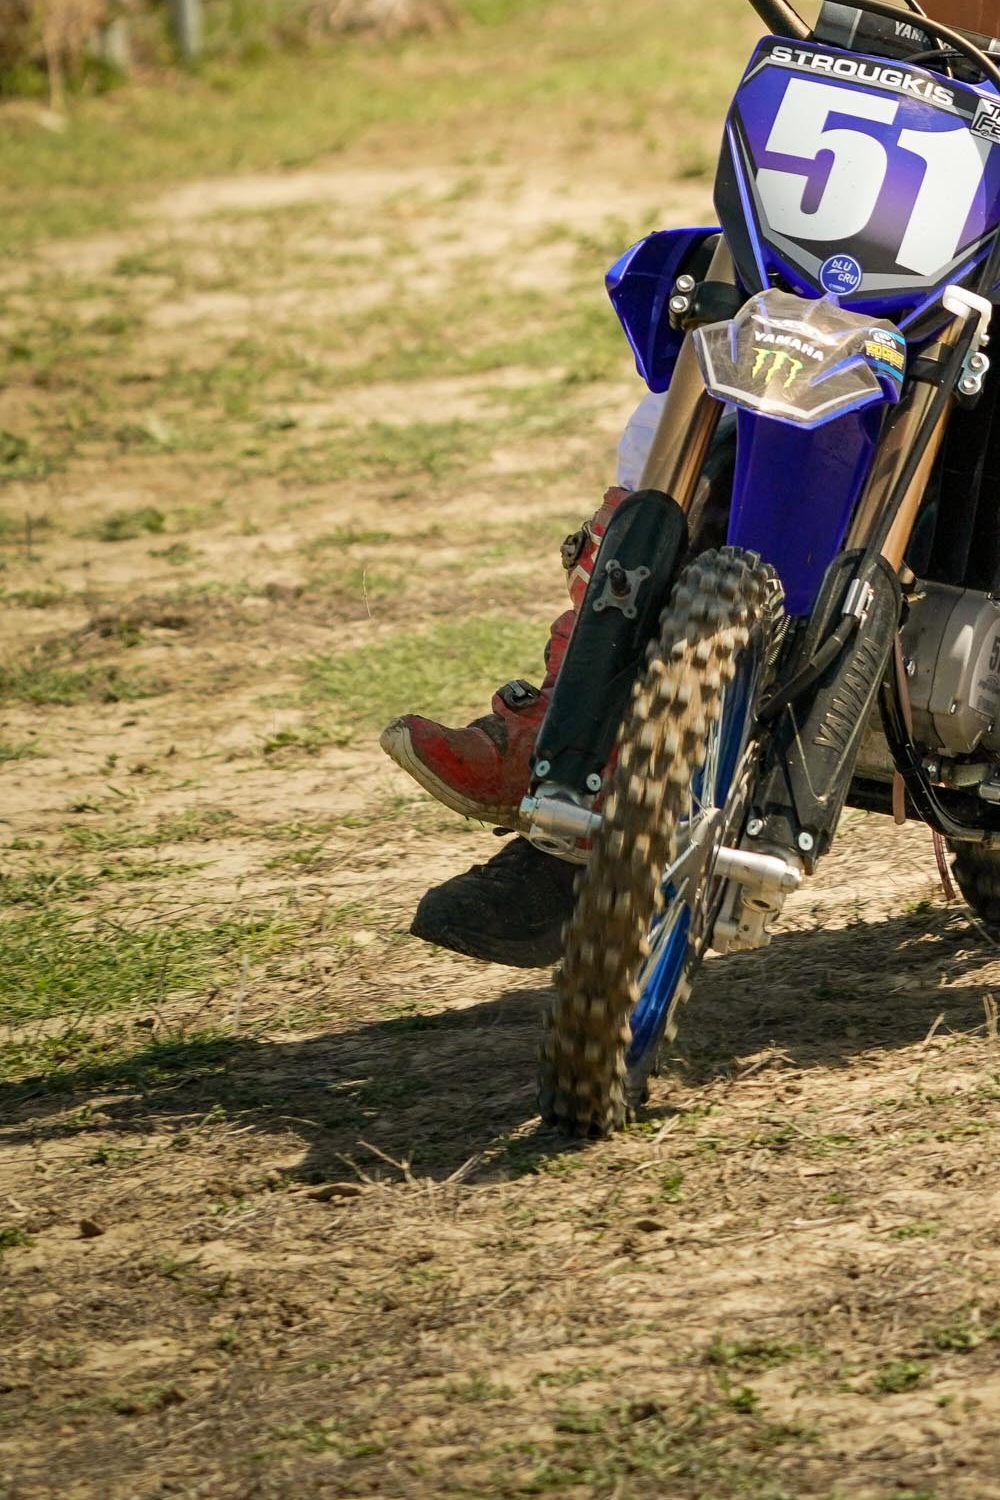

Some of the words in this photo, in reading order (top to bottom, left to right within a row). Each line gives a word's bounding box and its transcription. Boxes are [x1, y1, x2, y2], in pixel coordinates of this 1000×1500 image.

[769, 45, 955, 106] STROUGKIS
[755, 77, 994, 277] 51
[754, 330, 824, 362] YAMAHA
[813, 636, 882, 753] YAMAHA
